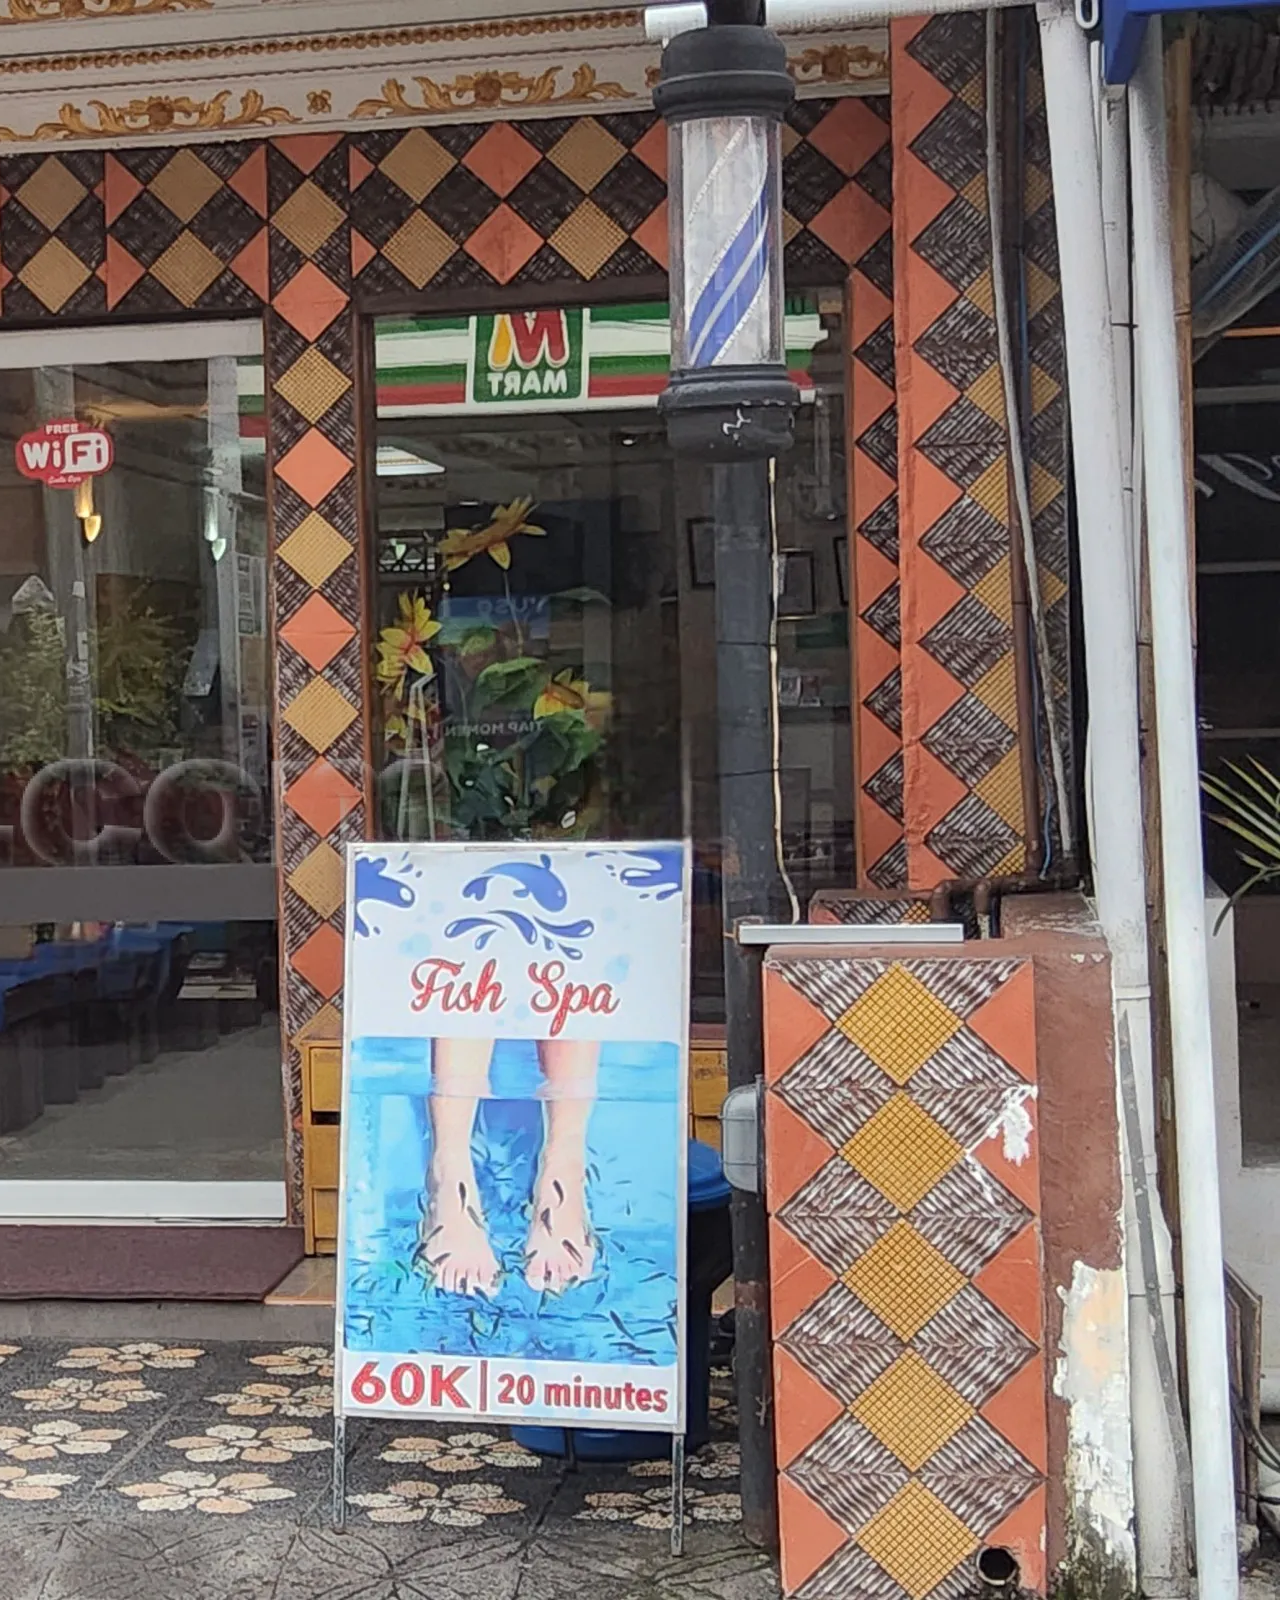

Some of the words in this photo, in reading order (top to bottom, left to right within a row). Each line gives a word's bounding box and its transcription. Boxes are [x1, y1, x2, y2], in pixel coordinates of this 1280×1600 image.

[45, 423, 79, 434] FREE
[410, 958, 507, 1013] Fish
[528, 960, 621, 1037] Spa
[350, 1361, 471, 1409] 60K
[496, 1374, 535, 1406] 20
[543, 1375, 669, 1413] minutes
